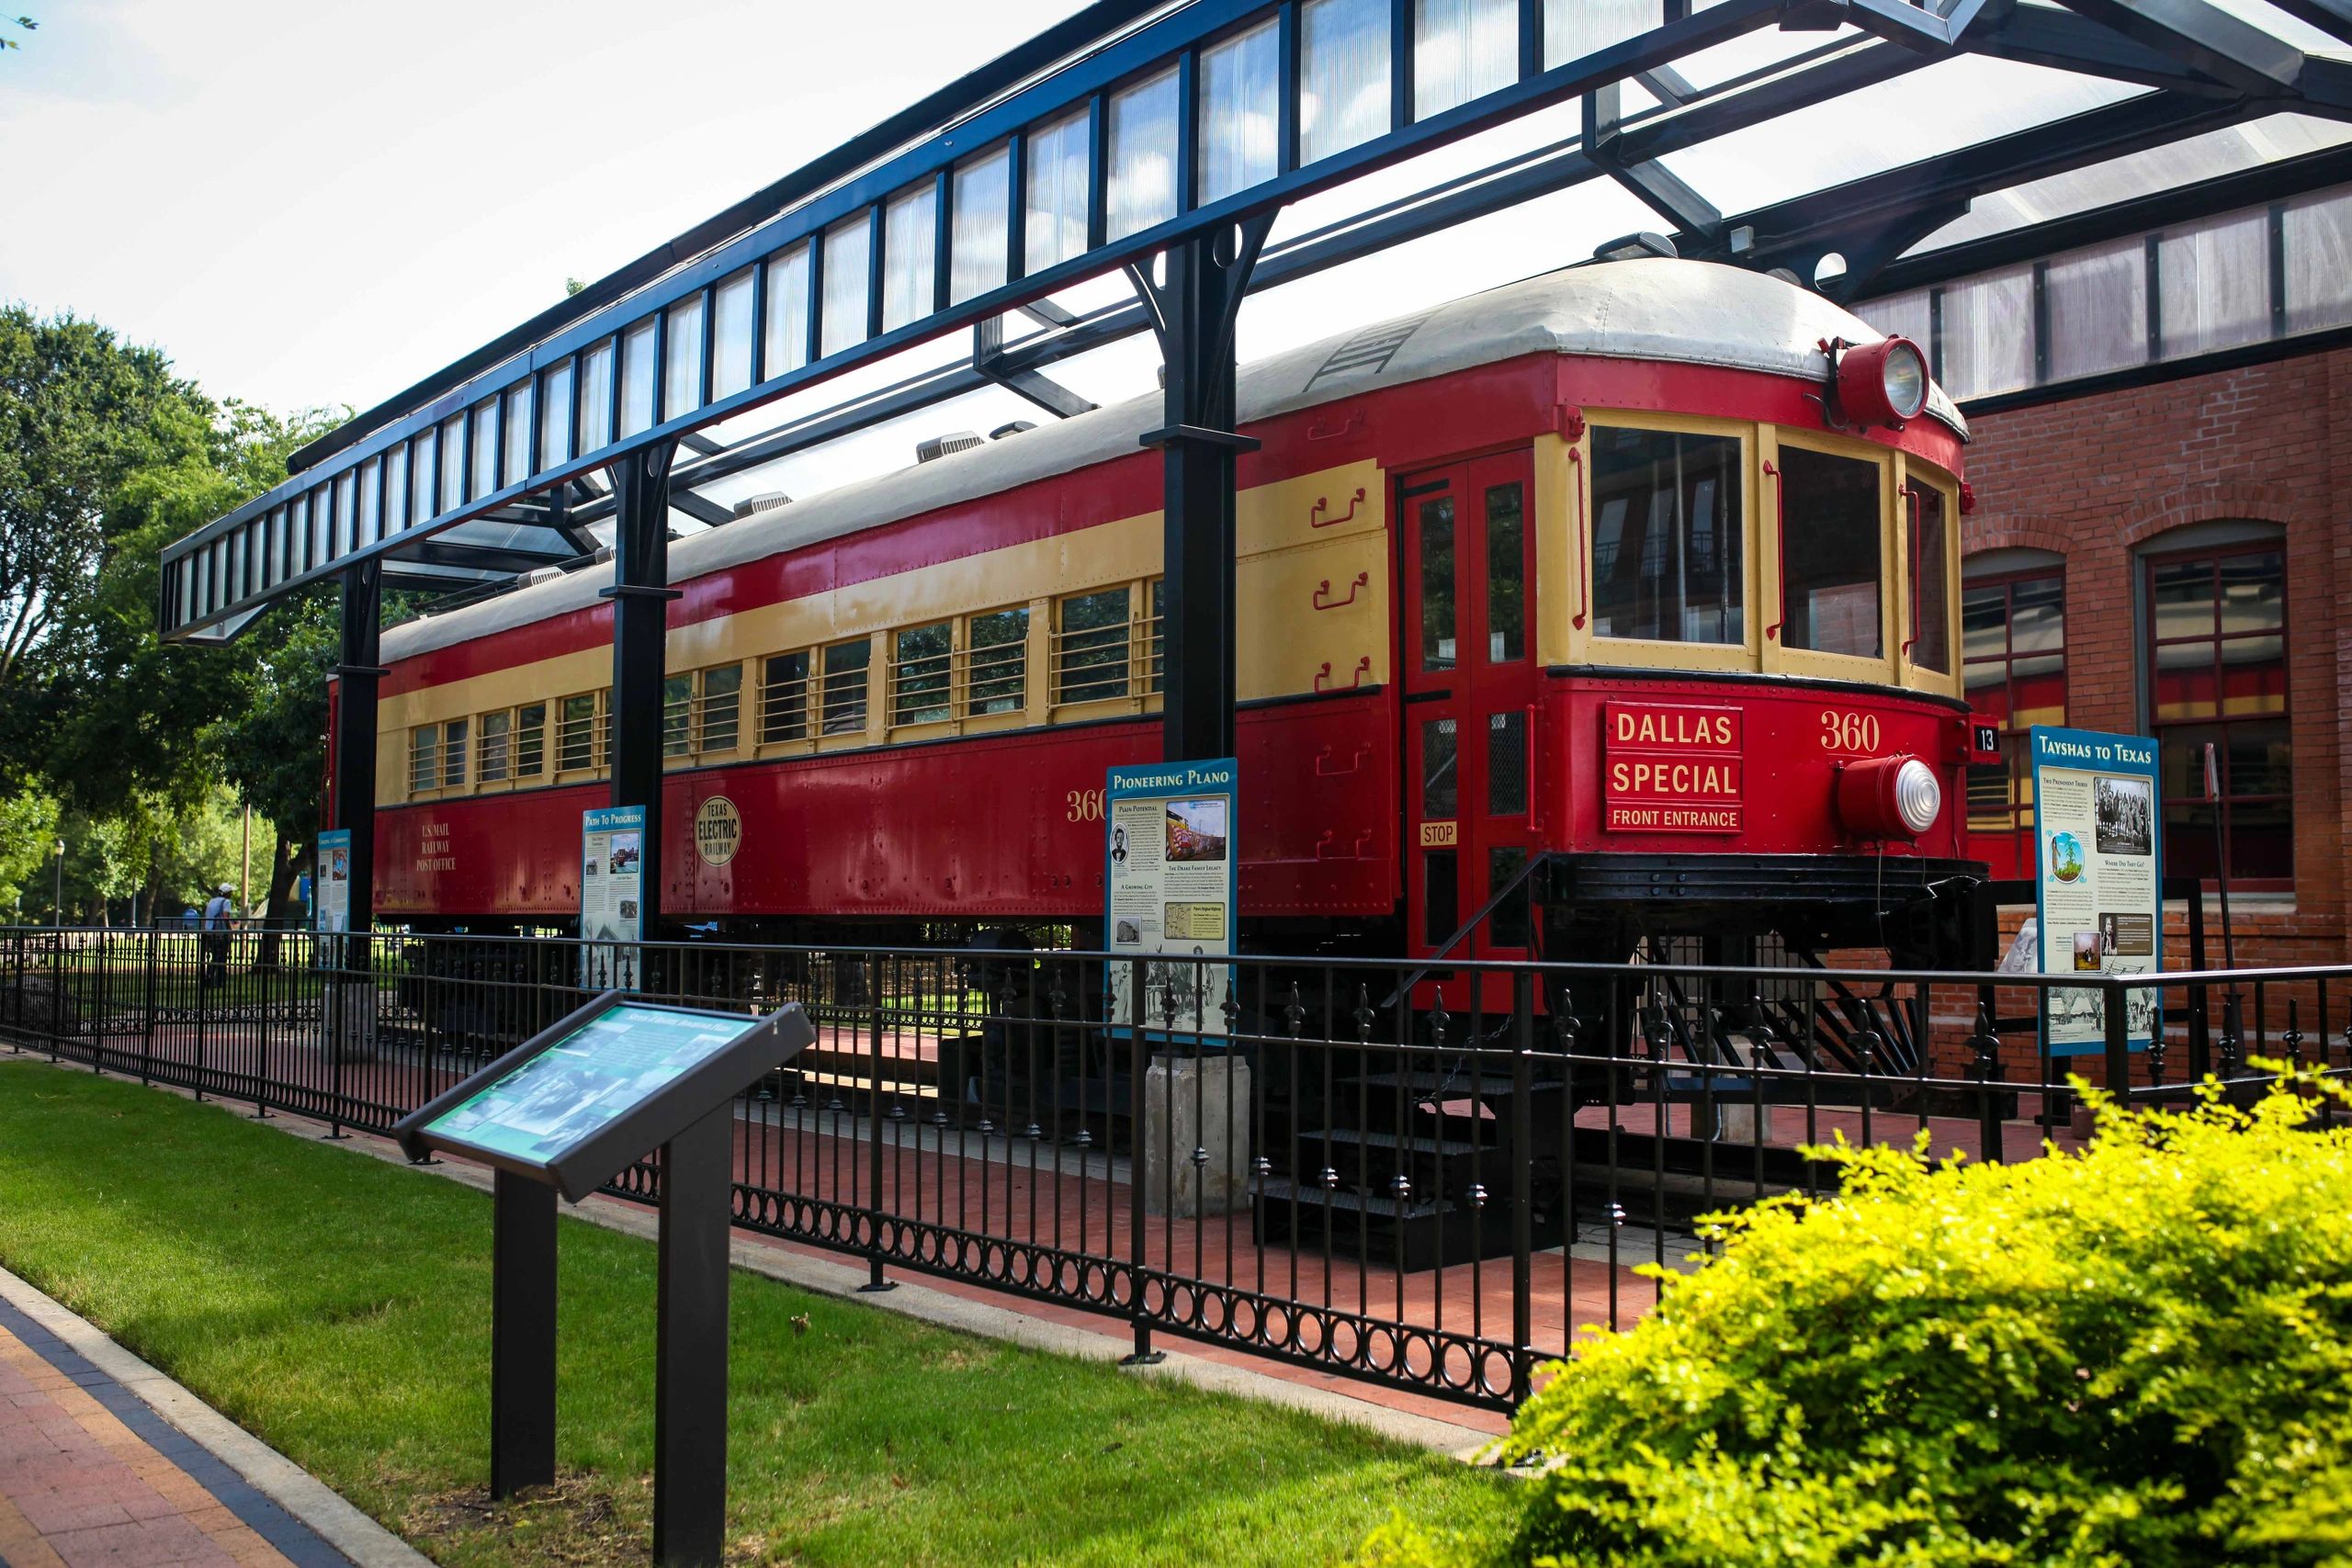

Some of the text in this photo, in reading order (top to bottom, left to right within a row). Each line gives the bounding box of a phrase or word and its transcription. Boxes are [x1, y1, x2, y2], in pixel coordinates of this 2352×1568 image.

[1618, 713, 1732, 745] DALLAS
[1821, 710, 1880, 752] 360
[1981, 729, 1994, 750] 13
[2039, 735, 2091, 758] TAYSHAS
[2114, 744, 2152, 764] TEXAS
[1114, 770, 1229, 789] PIONEERING PLANO
[1612, 763, 1737, 794] SPECIAL
[610, 813, 641, 825] PROGRESS
[707, 803, 728, 818] TEXAS
[1613, 809, 1737, 827] FRONT ENTRANCE
[433, 822, 450, 837] MAIL
[698, 818, 737, 840] ELECTRIC
[1424, 825, 1453, 842] STOP
[422, 840, 450, 854] RAILWAY
[705, 841, 731, 856] RAILWAY
[416, 857, 457, 872] POST OFFICE
